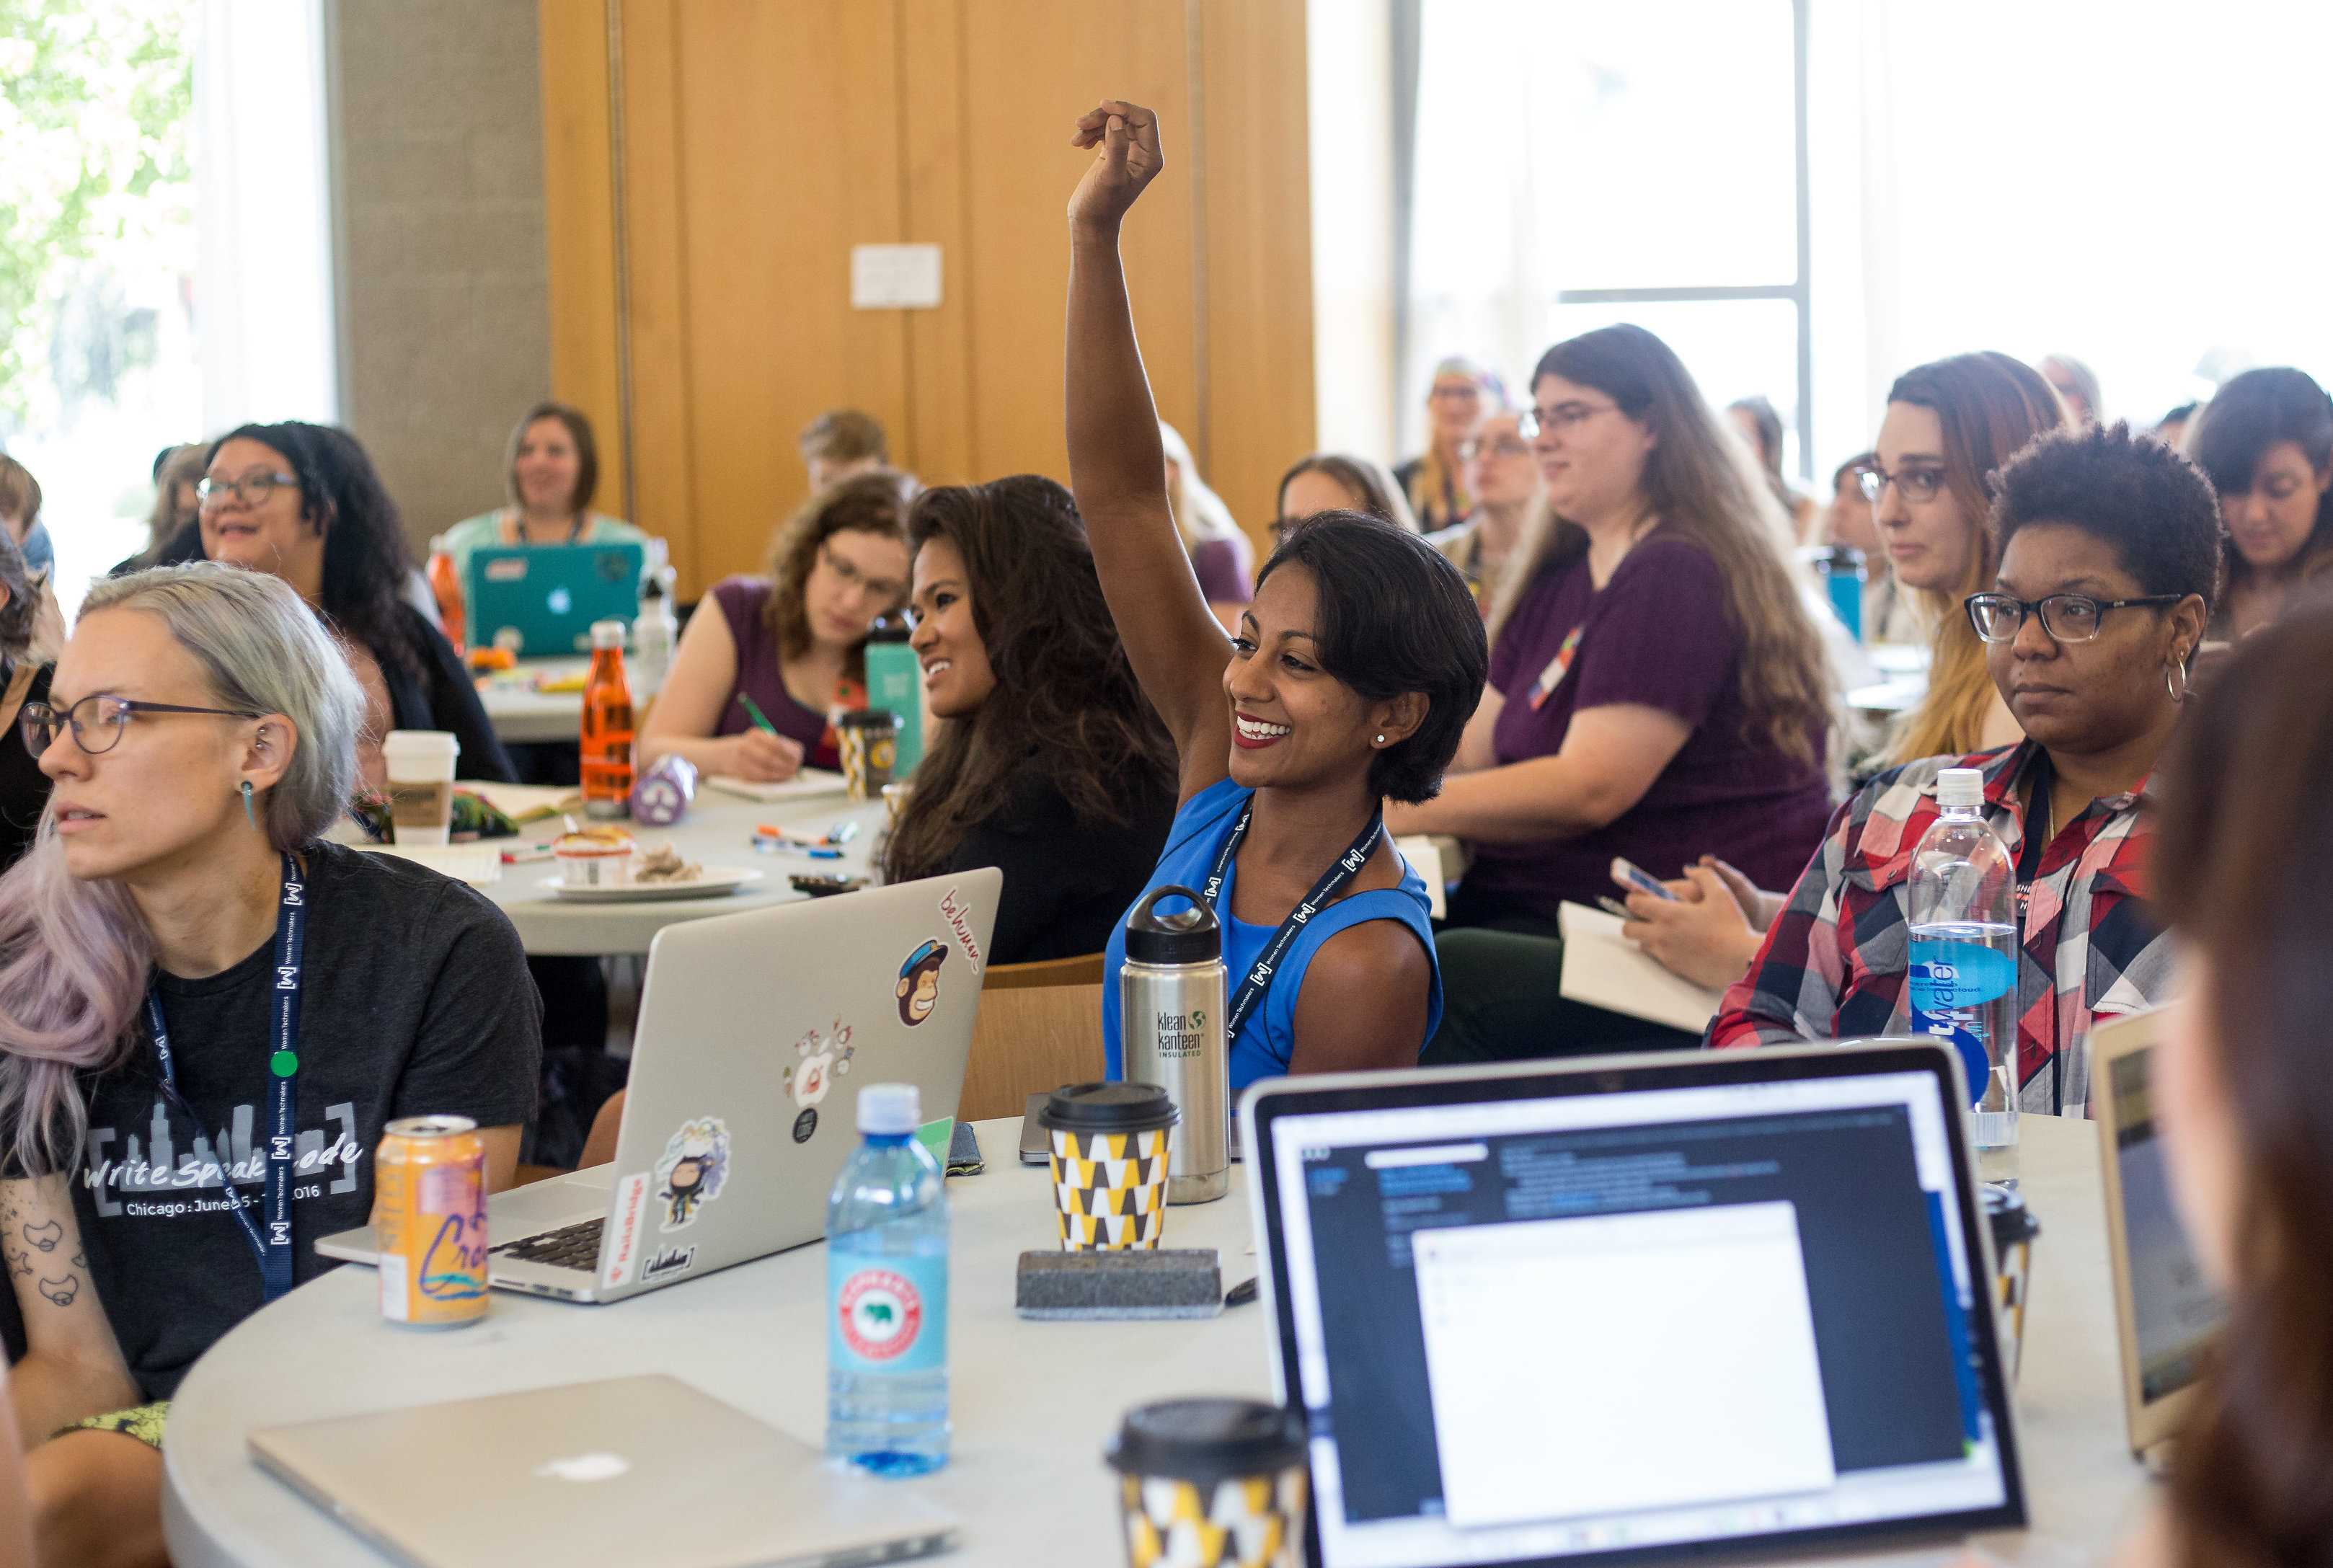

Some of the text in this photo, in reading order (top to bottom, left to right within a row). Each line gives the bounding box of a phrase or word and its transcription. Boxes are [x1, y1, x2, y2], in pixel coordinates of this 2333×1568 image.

[1310, 871, 1345, 905] Women Techmakers
[284, 911, 295, 965] Women Techmakers
[1265, 924, 1296, 965] Women Techmakers
[1157, 1011, 1187, 1031] klean
[1229, 1011, 1240, 1029] Women
[1236, 987, 1254, 1013] Techmakers
[1158, 1032, 1200, 1050] kanteen
[84, 1158, 169, 1190] Write
[292, 1133, 363, 1170] ode
[292, 1184, 320, 1200] 016
[248, 1227, 266, 1257] Techmaker
